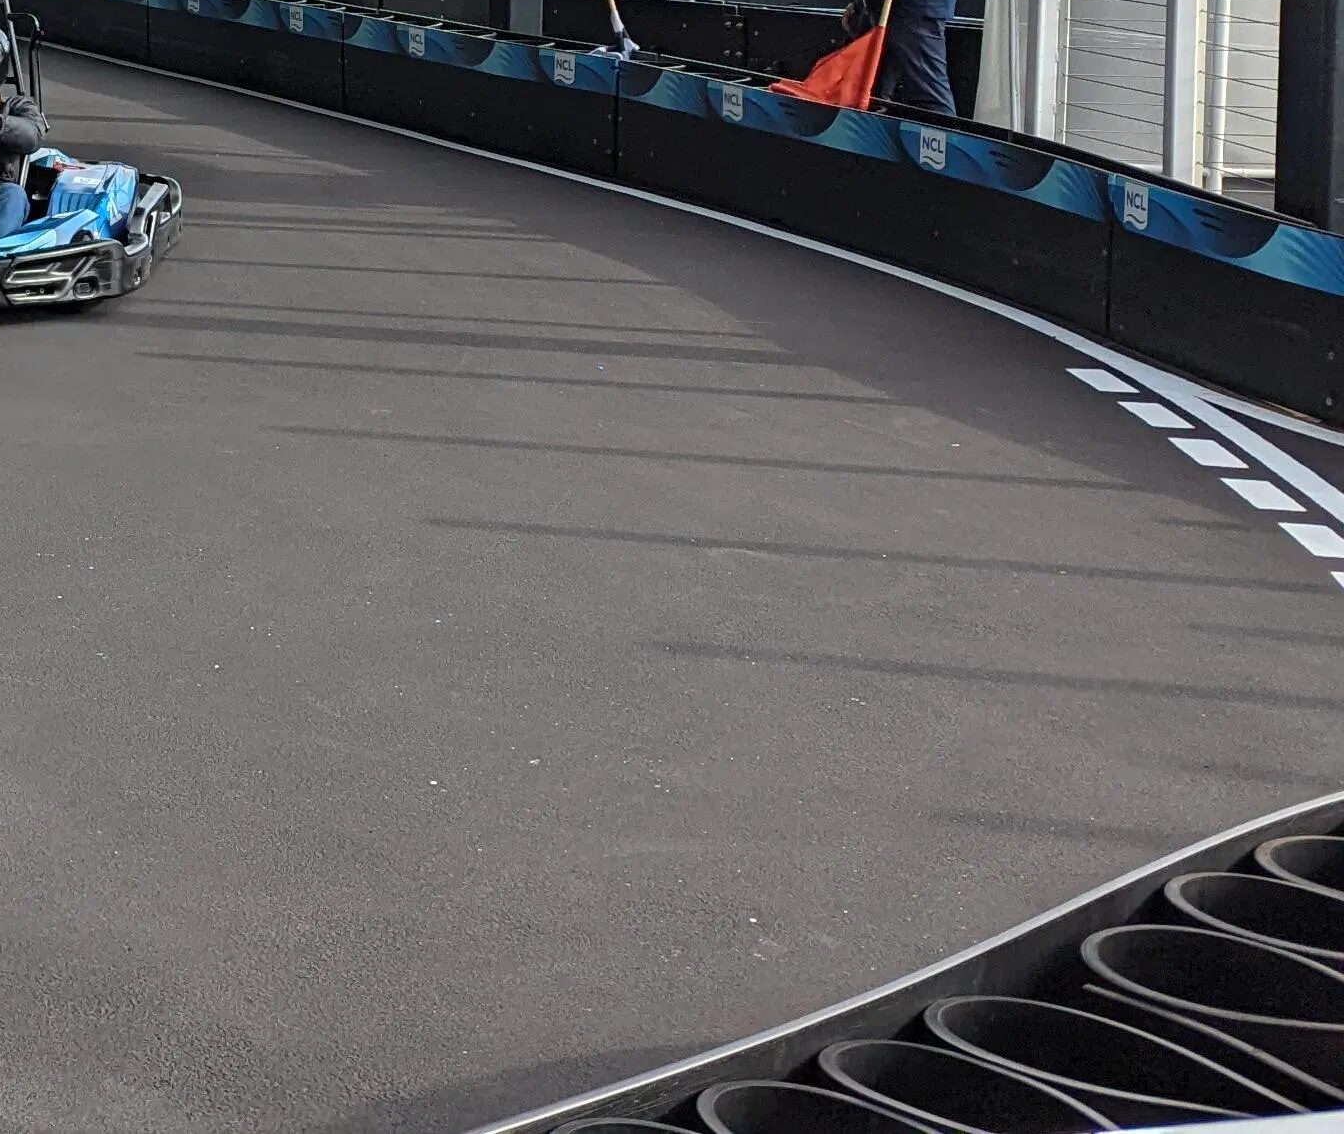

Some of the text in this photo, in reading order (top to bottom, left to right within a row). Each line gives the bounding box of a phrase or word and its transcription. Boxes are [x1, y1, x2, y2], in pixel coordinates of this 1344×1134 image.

[556, 57, 574, 72] NCL
[724, 91, 742, 107] NCL
[922, 136, 945, 155] NCL
[1125, 190, 1147, 213] NCL
